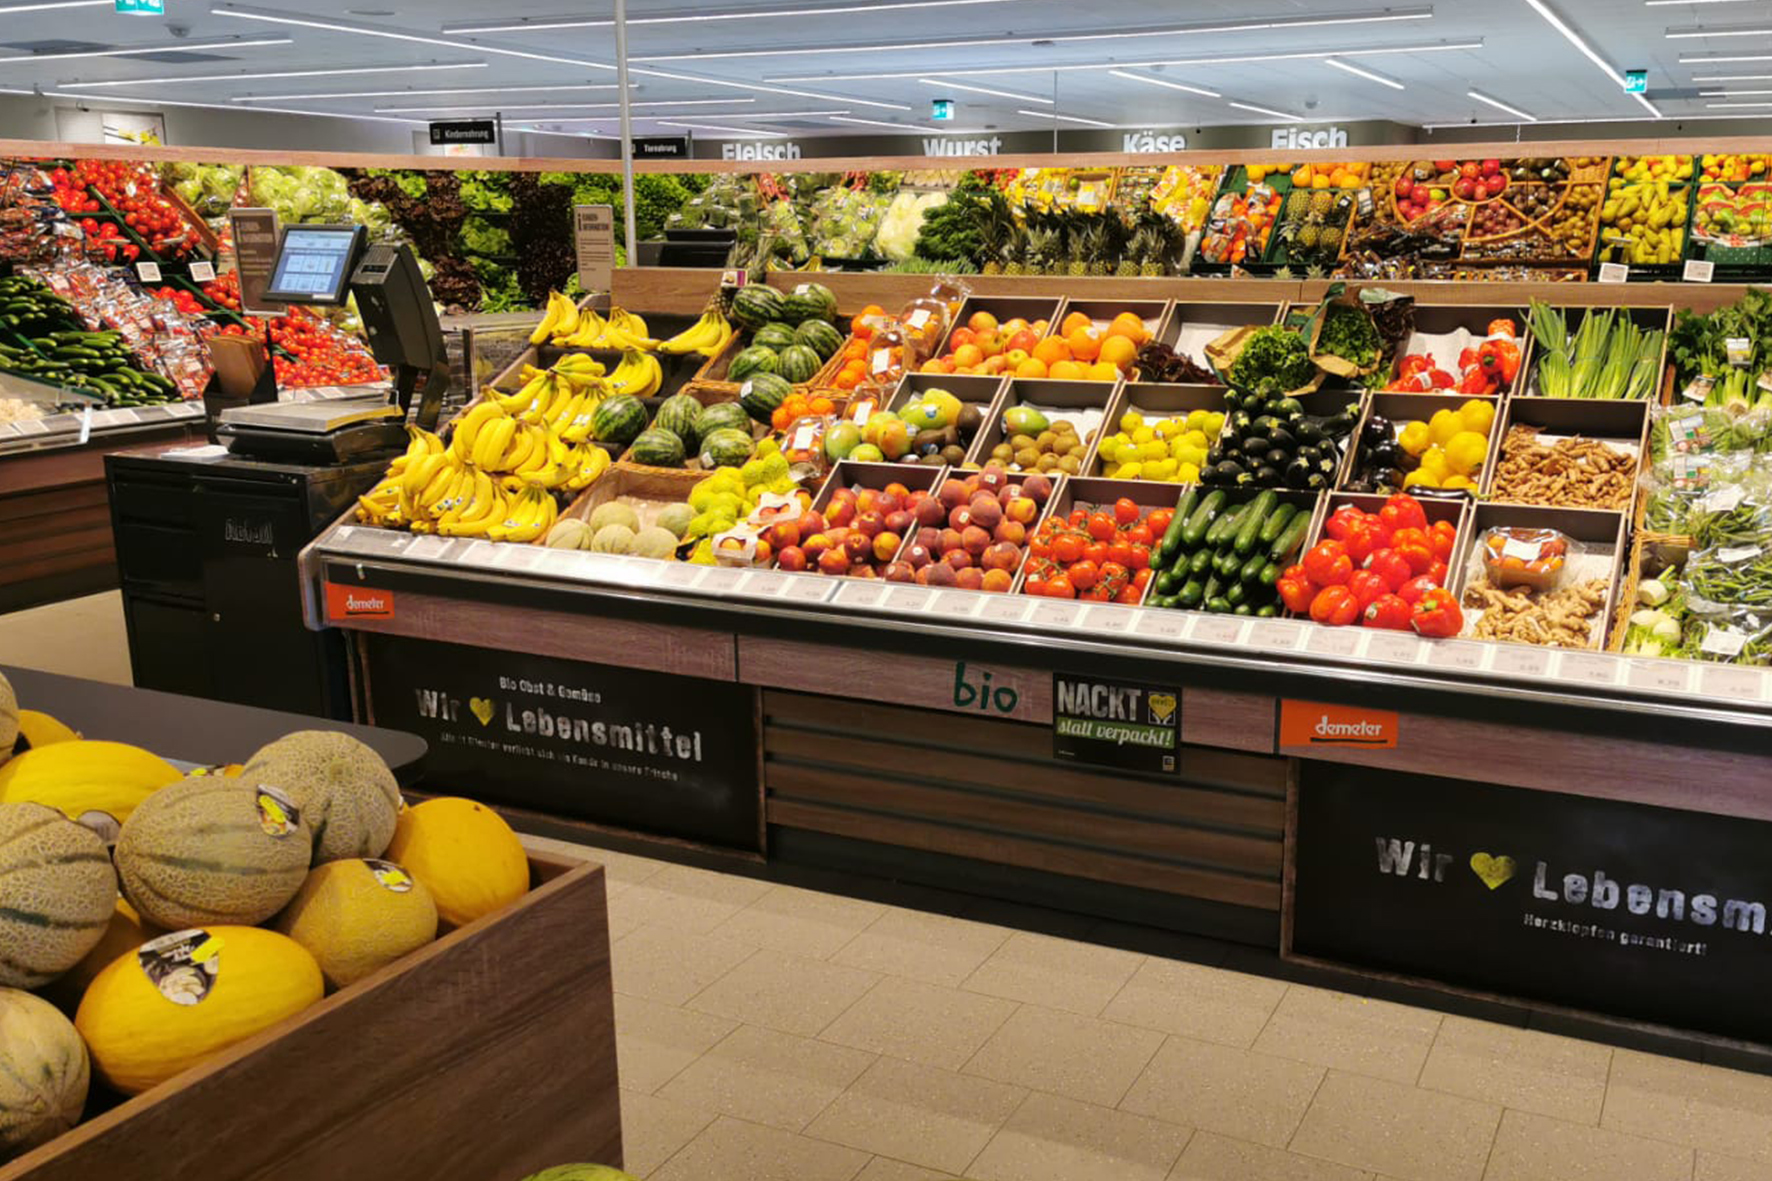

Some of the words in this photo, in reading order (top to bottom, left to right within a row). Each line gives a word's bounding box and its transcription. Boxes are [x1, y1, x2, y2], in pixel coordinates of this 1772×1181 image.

[922, 136, 1002, 157] Wurst
[1122, 131, 1187, 154] Käse
[1271, 127, 1348, 150] Fisch
[721, 142, 801, 161] Fleisch
[346, 594, 385, 610] demeter
[499, 676, 517, 691] Bio
[953, 661, 1019, 714] bio
[1057, 680, 1143, 722] NACKT
[415, 688, 462, 723] Wir
[505, 701, 703, 762] Lebensmittel
[1057, 719, 1094, 737] statt
[1095, 723, 1174, 746] verpackt!
[1315, 715, 1383, 736] demeter
[1375, 836, 1455, 884] Wir
[1532, 861, 1772, 936] Lebensm
[1523, 913, 1616, 940] Herzklopfen
